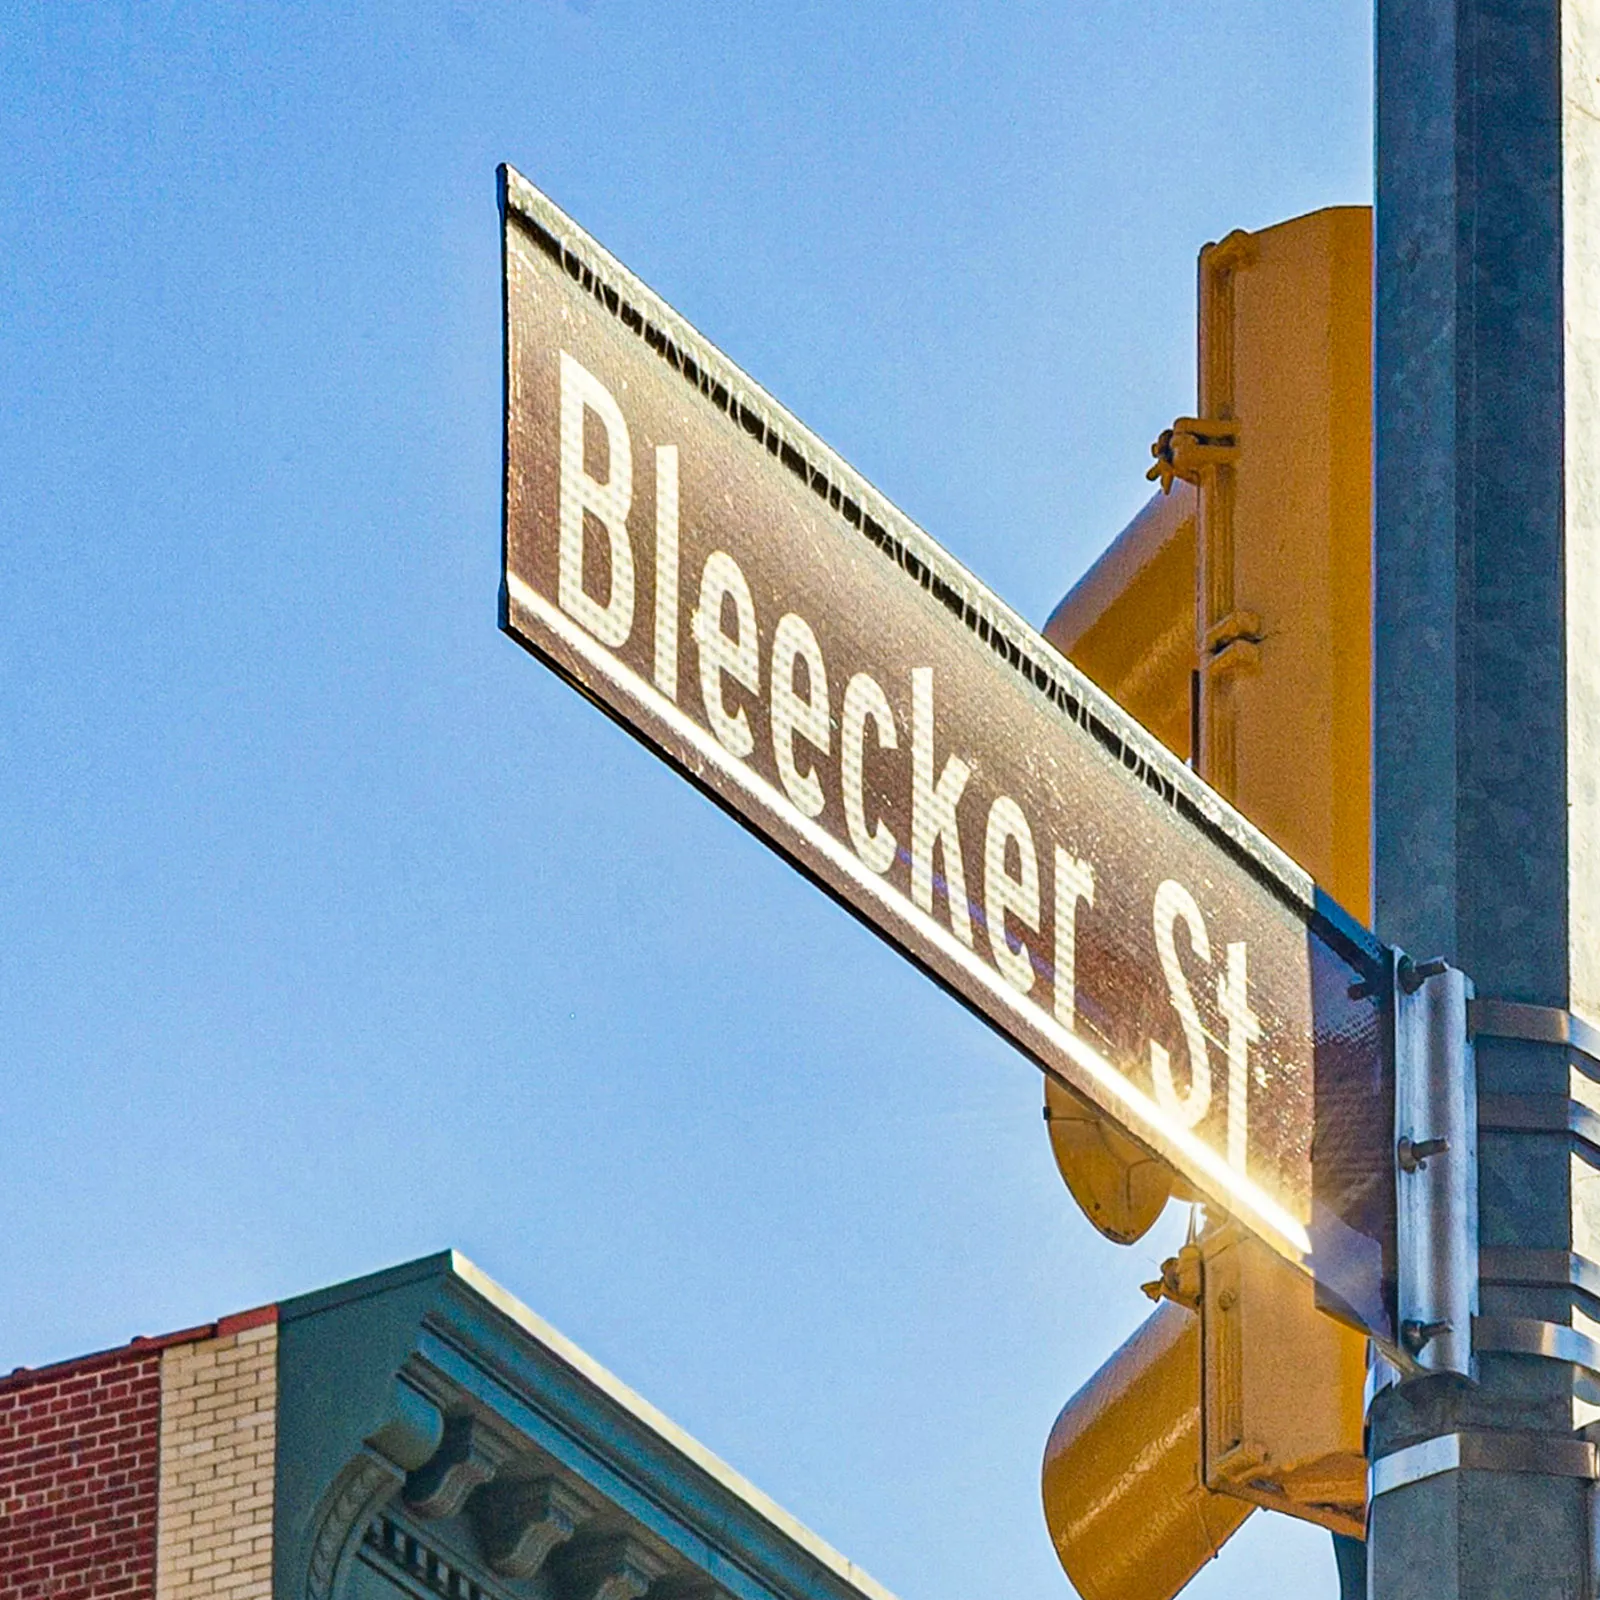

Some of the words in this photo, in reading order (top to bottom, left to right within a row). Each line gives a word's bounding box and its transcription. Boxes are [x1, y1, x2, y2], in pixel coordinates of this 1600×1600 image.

[557, 348, 1098, 1032] Bleecker
[1150, 876, 1266, 1184] St
[559, 230, 784, 455] GREENWICH
[800, 446, 952, 608] VILLAGE
[960, 585, 1100, 740] HISTORIC
[1119, 728, 1182, 815] DIST
